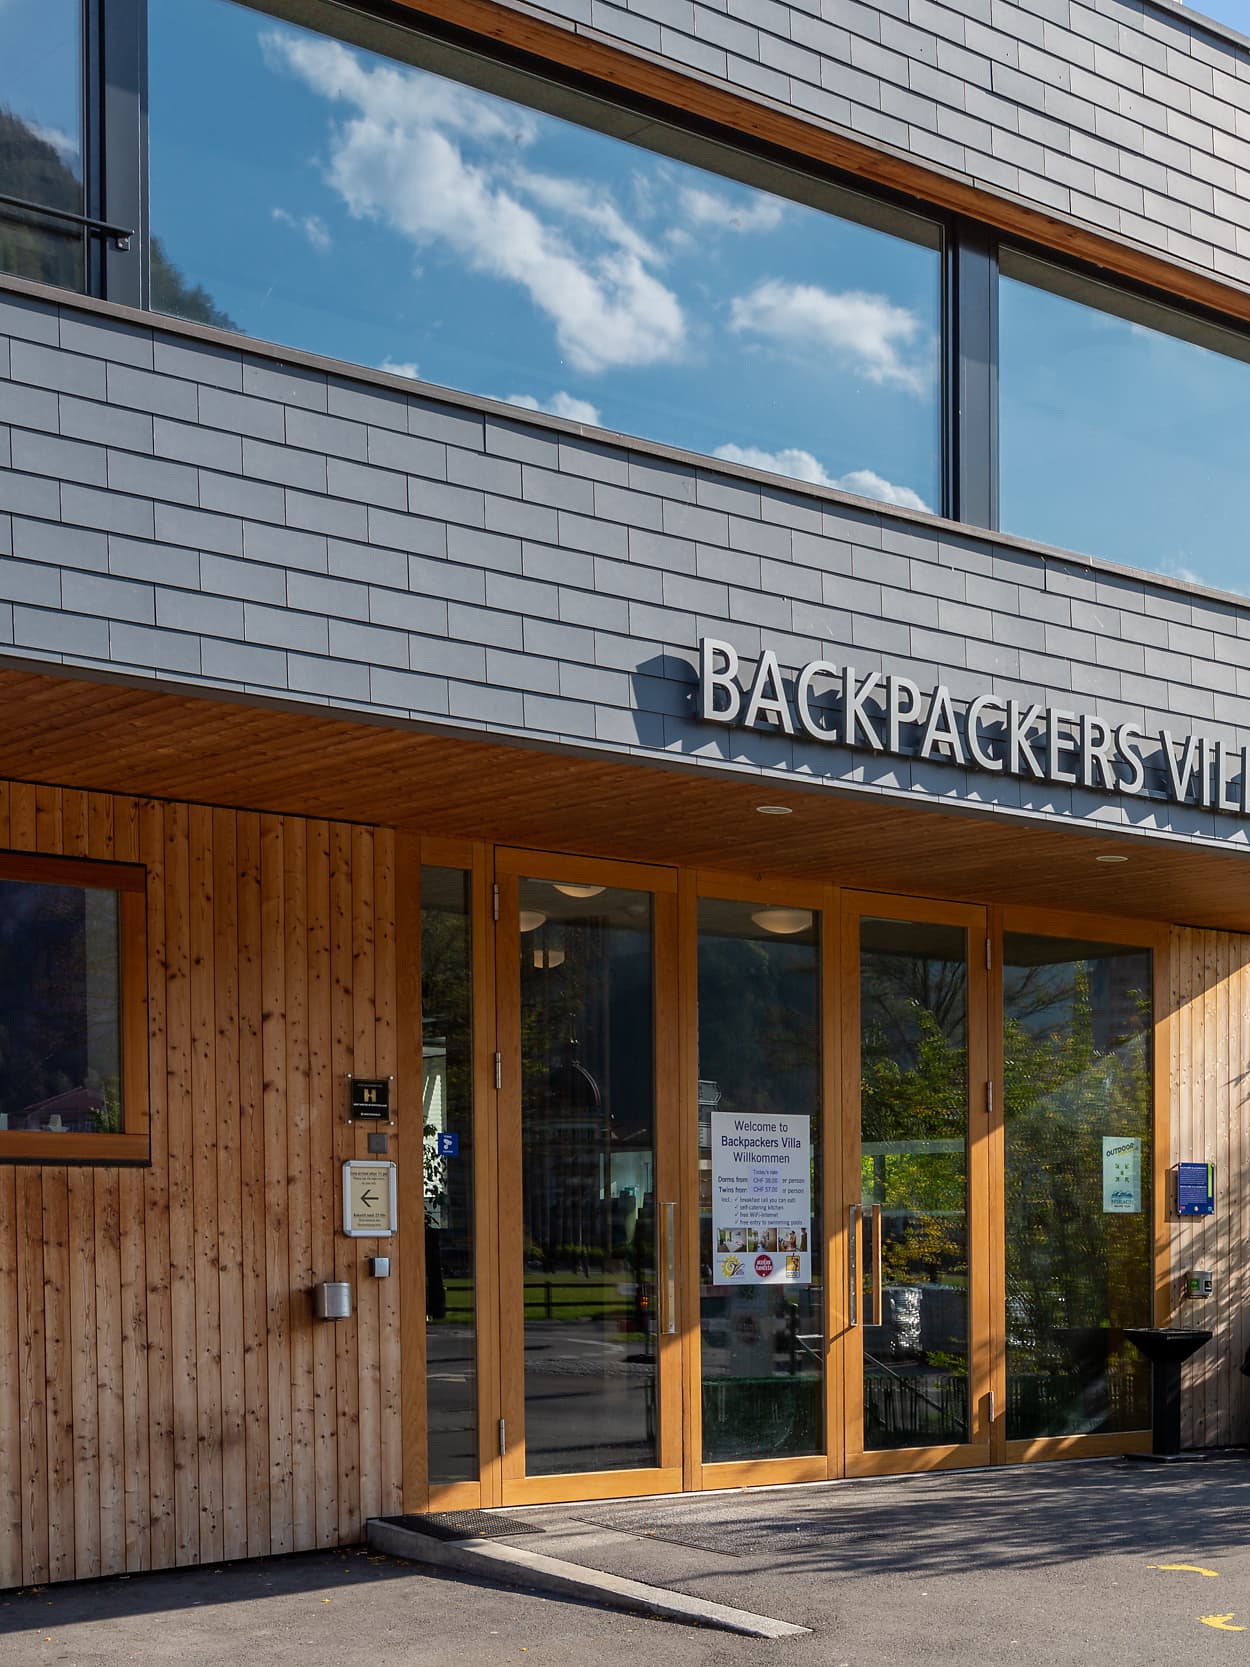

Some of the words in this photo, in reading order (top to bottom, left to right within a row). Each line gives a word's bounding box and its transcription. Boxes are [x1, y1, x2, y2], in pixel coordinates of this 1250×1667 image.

[697, 636, 1145, 796] BACKPACKERS
[734, 1120, 777, 1132] Welcome
[779, 1122, 788, 1132] to
[721, 1136, 779, 1149] Backpackers
[781, 1137, 801, 1148] Villa
[733, 1151, 790, 1163] Willkommen
